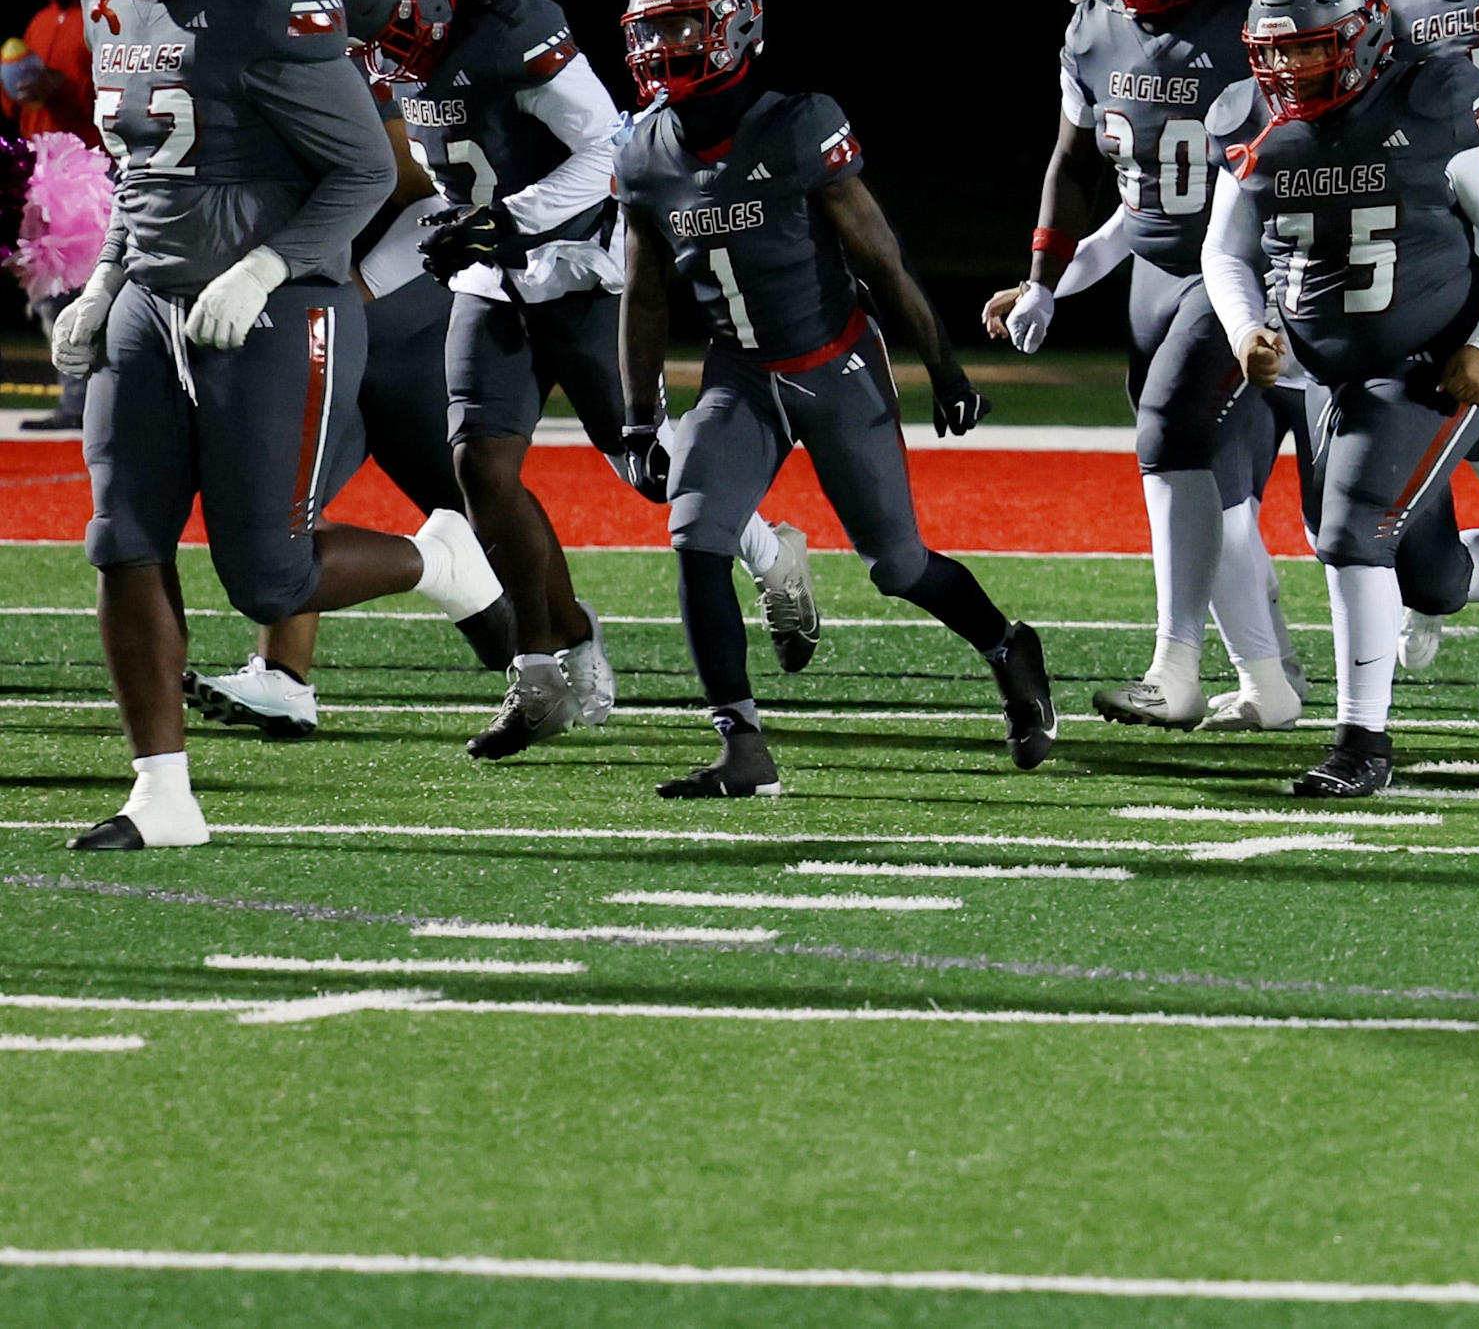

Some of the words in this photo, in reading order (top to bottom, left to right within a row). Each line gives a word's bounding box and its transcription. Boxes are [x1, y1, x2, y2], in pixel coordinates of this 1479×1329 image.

[101, 43, 186, 73] EAGLES
[1109, 71, 1199, 105] EAGLES
[401, 97, 467, 127] EAGLES
[1275, 163, 1386, 199] EAGLES
[669, 200, 764, 238] EAGLES
[1275, 205, 1397, 315] 75
[709, 247, 760, 349] 1
